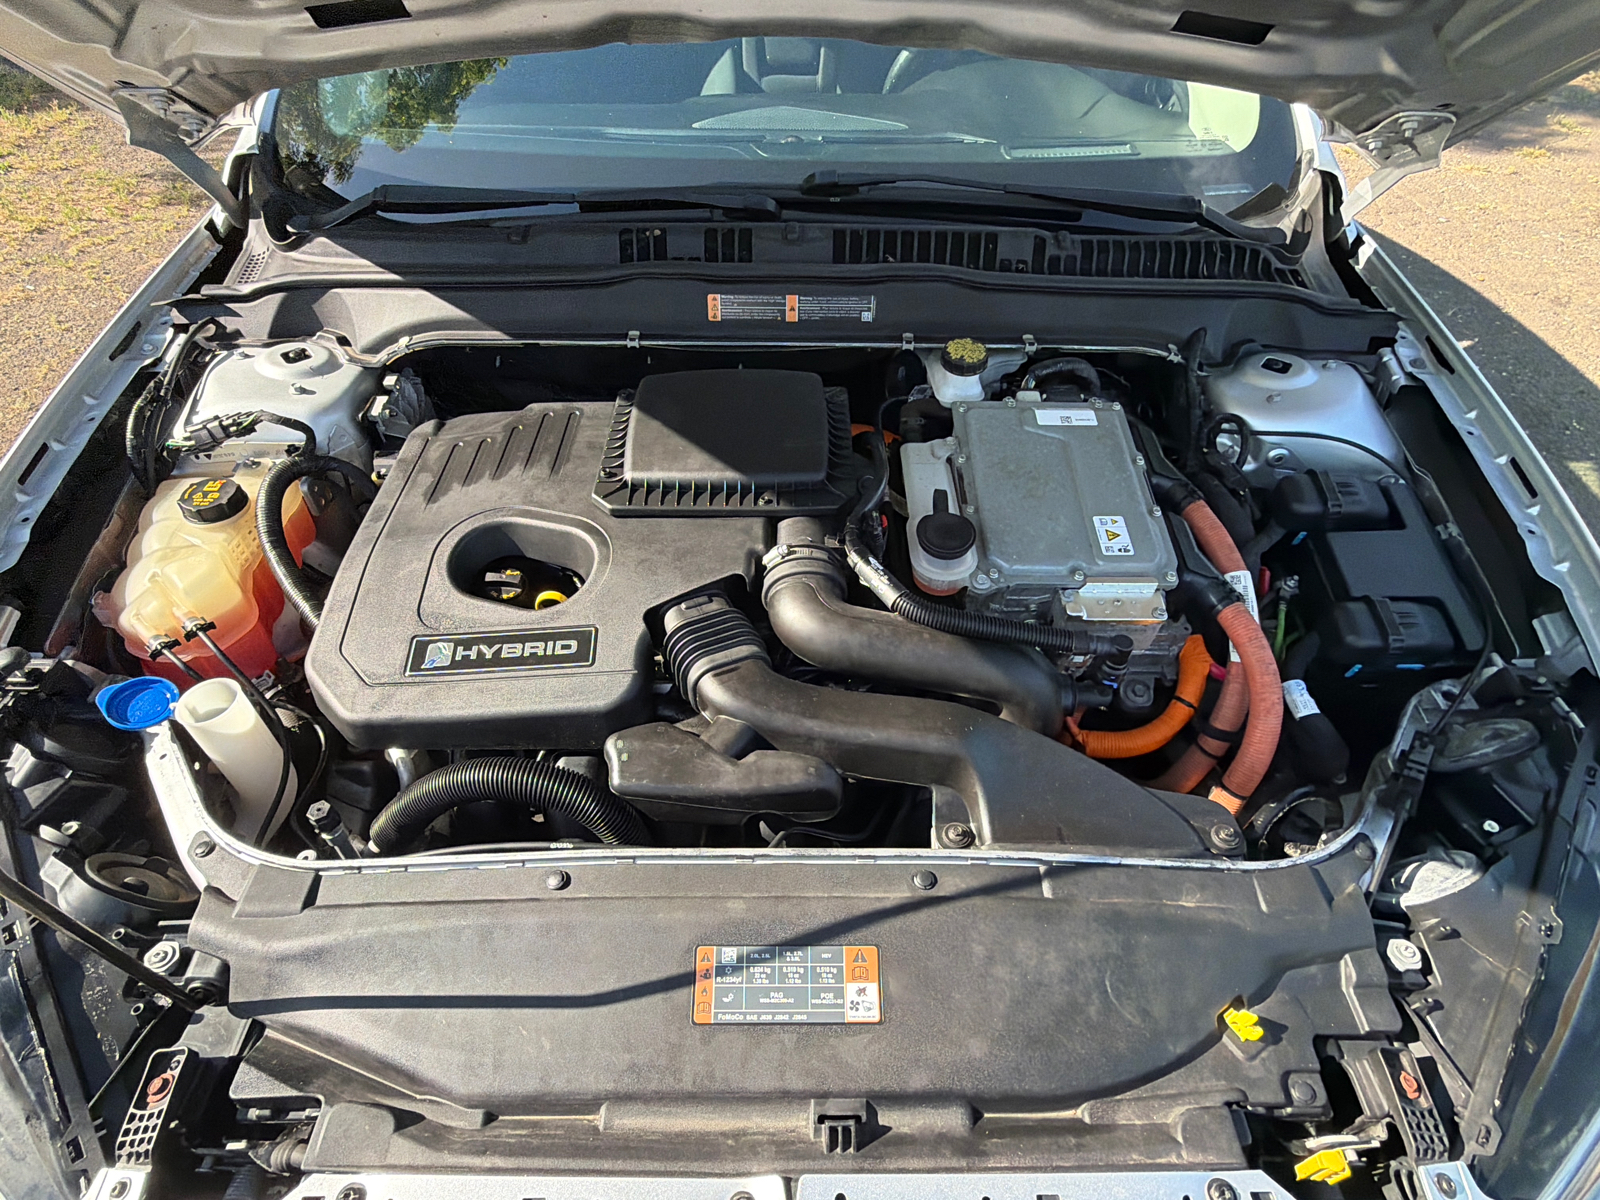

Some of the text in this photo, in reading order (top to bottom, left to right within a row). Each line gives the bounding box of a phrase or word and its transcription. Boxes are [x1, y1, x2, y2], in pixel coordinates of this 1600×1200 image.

[455, 639, 578, 661] HYBRID
[716, 976, 742, 984] R-1234yf
[717, 1013, 744, 1021] FoMoCo
